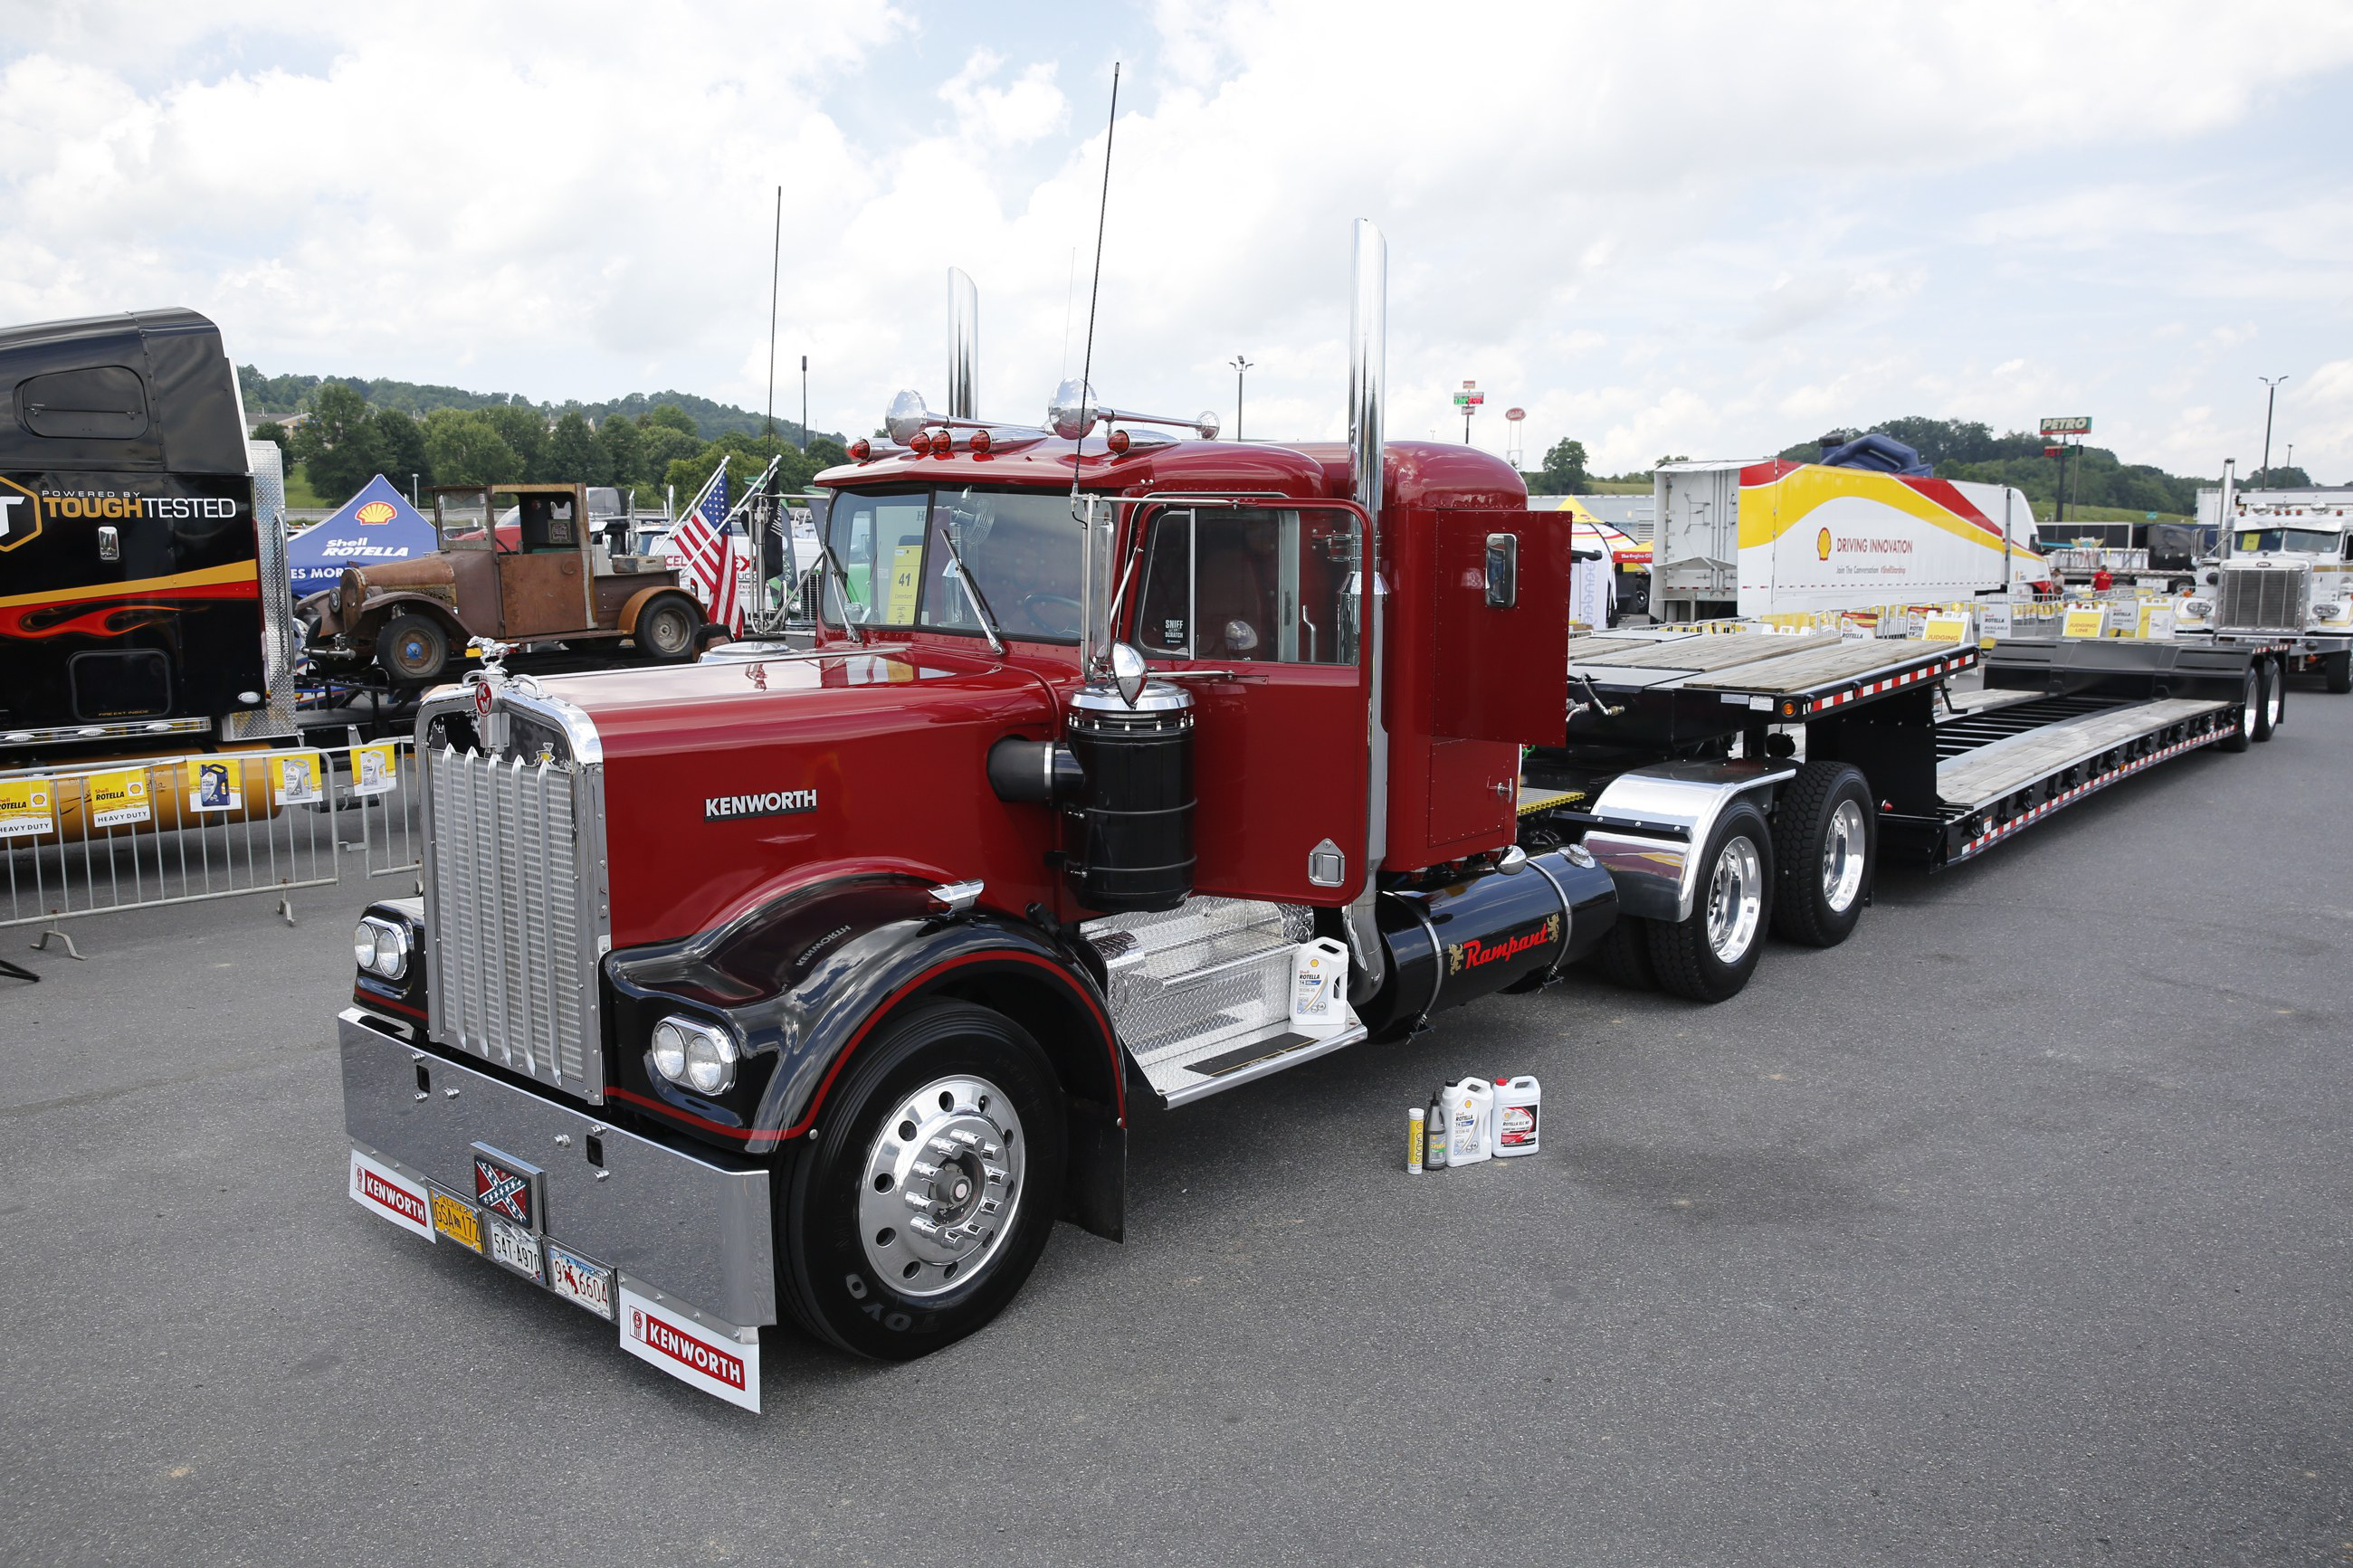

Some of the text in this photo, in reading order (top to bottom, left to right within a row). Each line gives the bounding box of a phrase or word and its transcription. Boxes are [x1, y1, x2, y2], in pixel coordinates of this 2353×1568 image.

[2042, 418, 2087, 430] PETRO
[43, 498, 236, 518] TOUGHTESTED
[326, 537, 368, 547] Shell
[1837, 537, 1913, 554] DRIVING INNOVATION
[321, 546, 409, 556] ROTELLA
[310, 567, 343, 578] MOR
[899, 572, 911, 587] 41
[1165, 619, 1184, 630] SNIFF
[96, 791, 125, 801] ROTELLA
[706, 789, 817, 817] KENWORTH
[0, 802, 27, 811] OTELLA
[98, 811, 148, 823] HEAVY DUTY
[27, 822, 50, 831] DUTY
[1463, 922, 1548, 970] Rampant
[1415, 1132, 1424, 1163] GADUS
[367, 1175, 425, 1222] KENWORTH
[434, 1201, 481, 1245] GSA 172
[578, 1272, 608, 1307] 6604
[650, 1322, 741, 1384] KENWORTH
